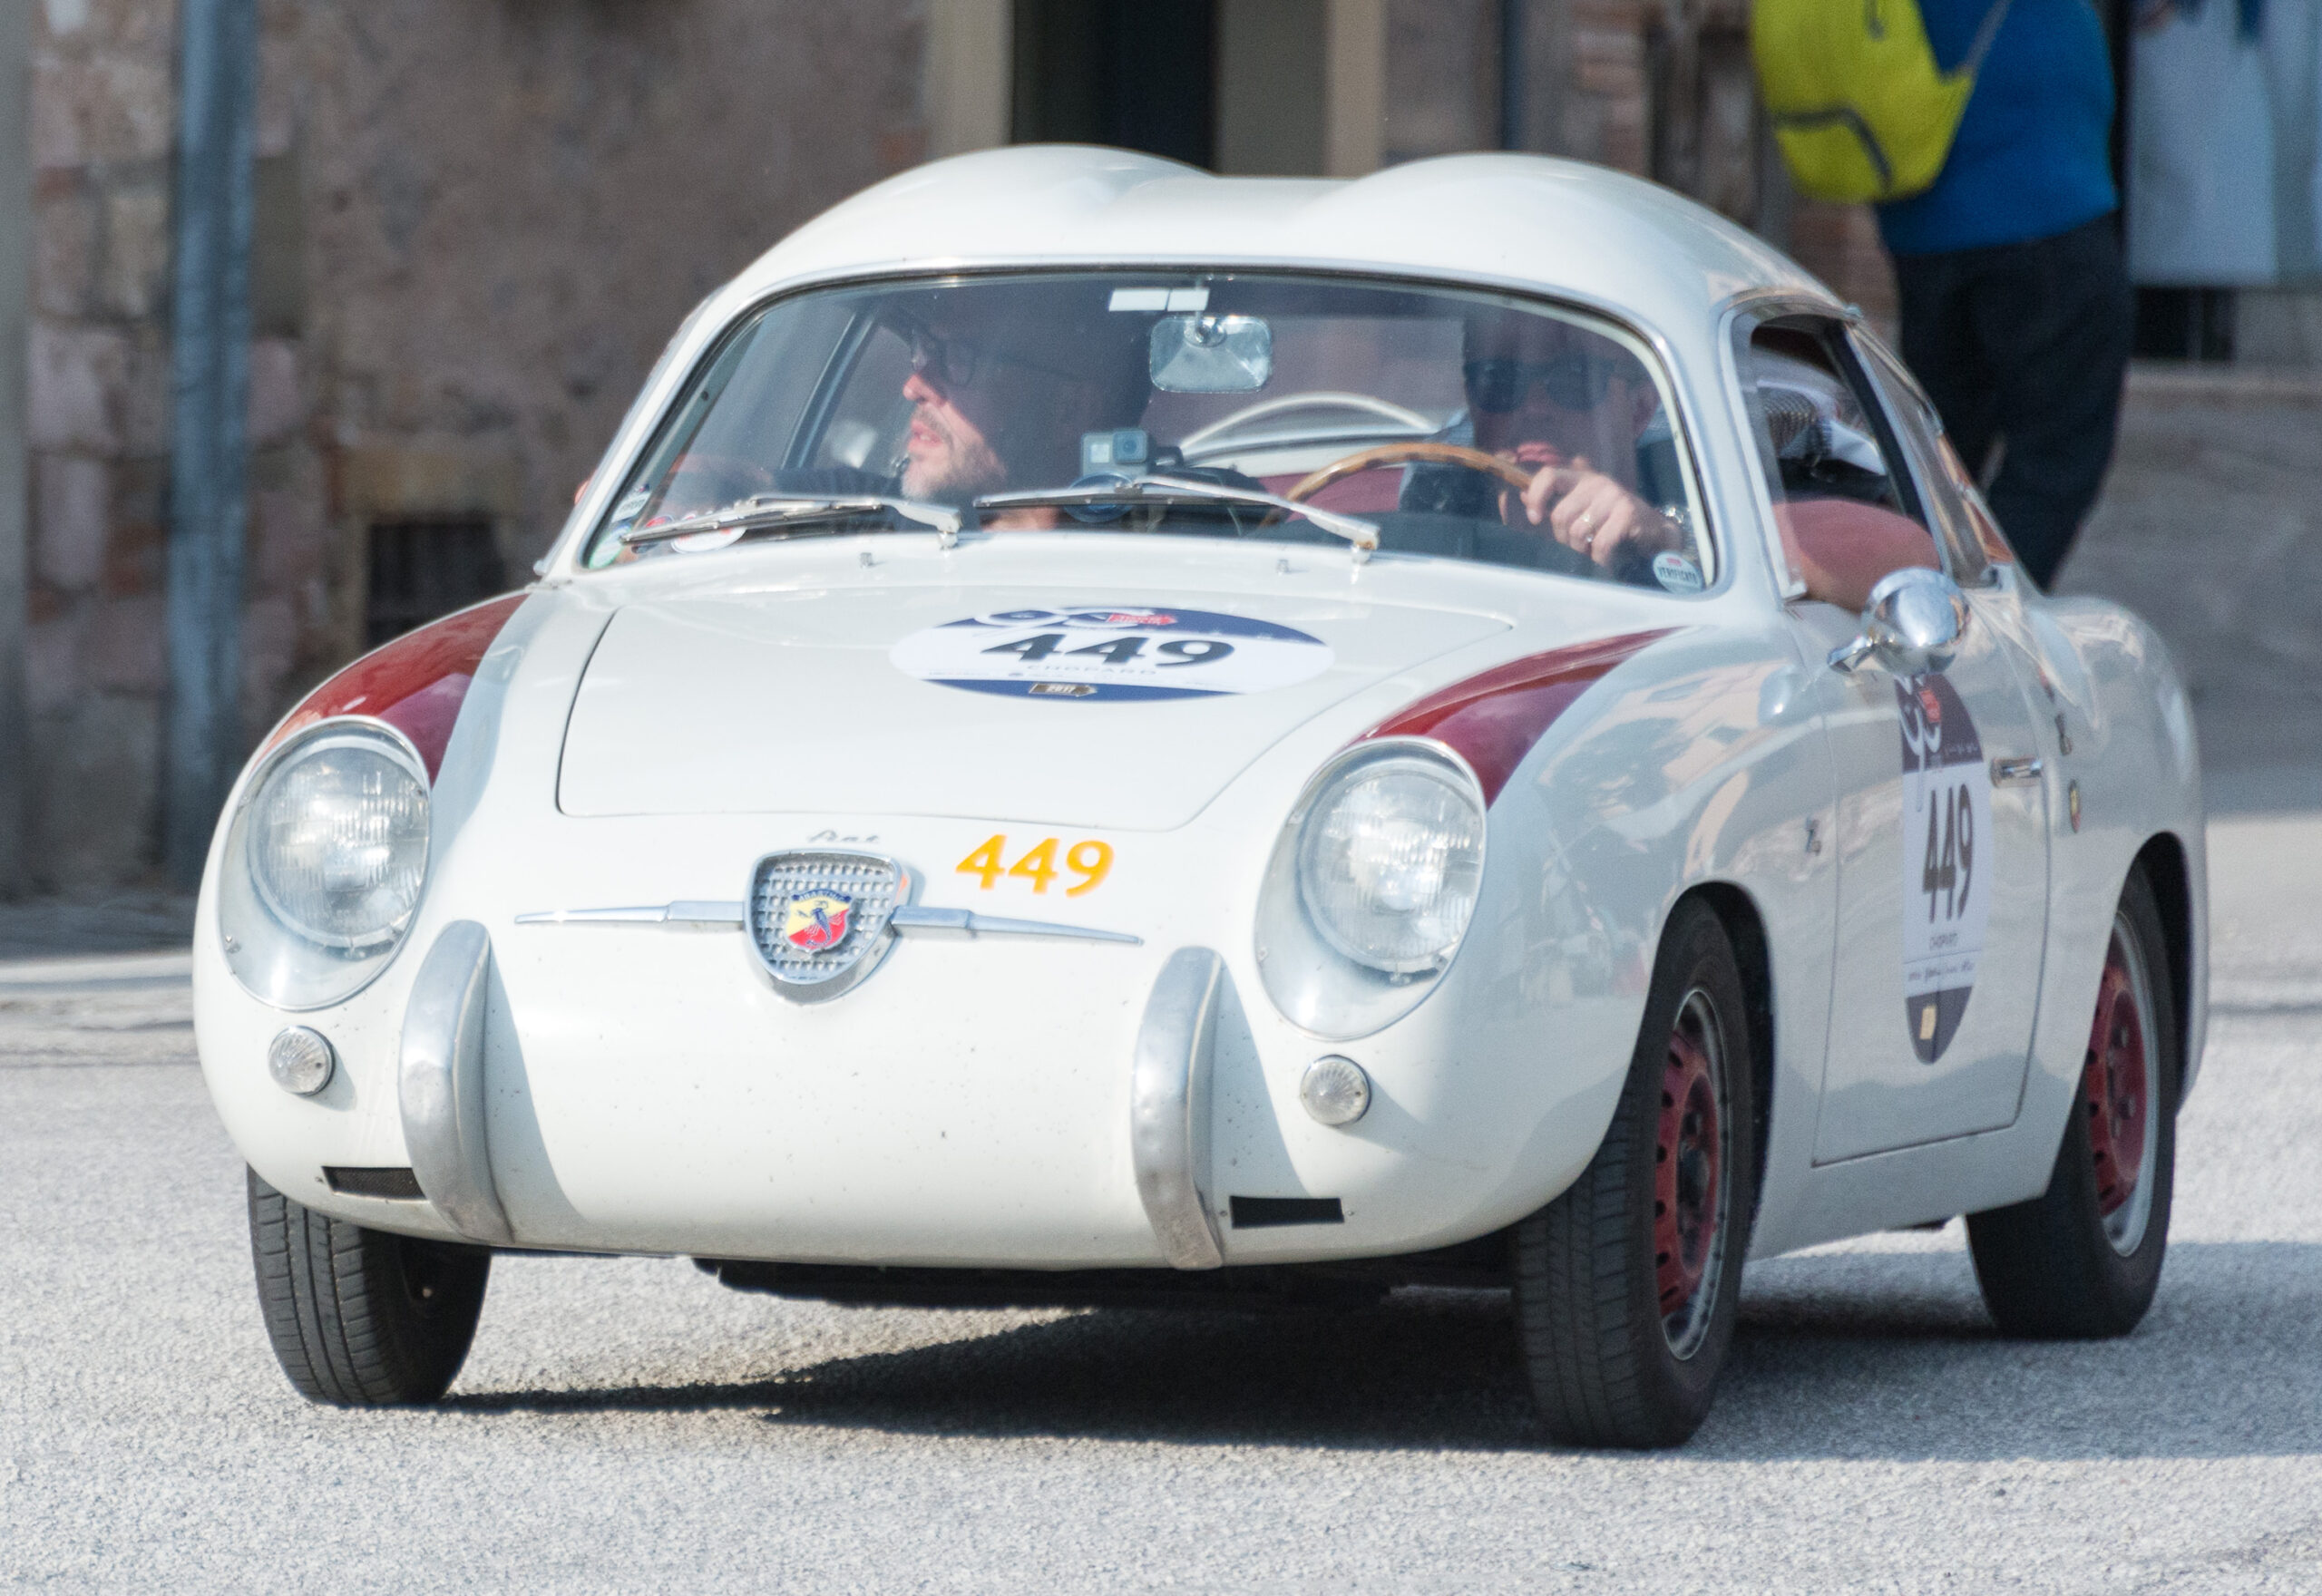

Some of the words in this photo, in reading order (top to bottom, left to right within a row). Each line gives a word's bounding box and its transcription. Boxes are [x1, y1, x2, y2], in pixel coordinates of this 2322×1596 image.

[981, 634, 1234, 667] 449
[955, 834, 1115, 898] 449
[1922, 783, 1973, 923] 449
